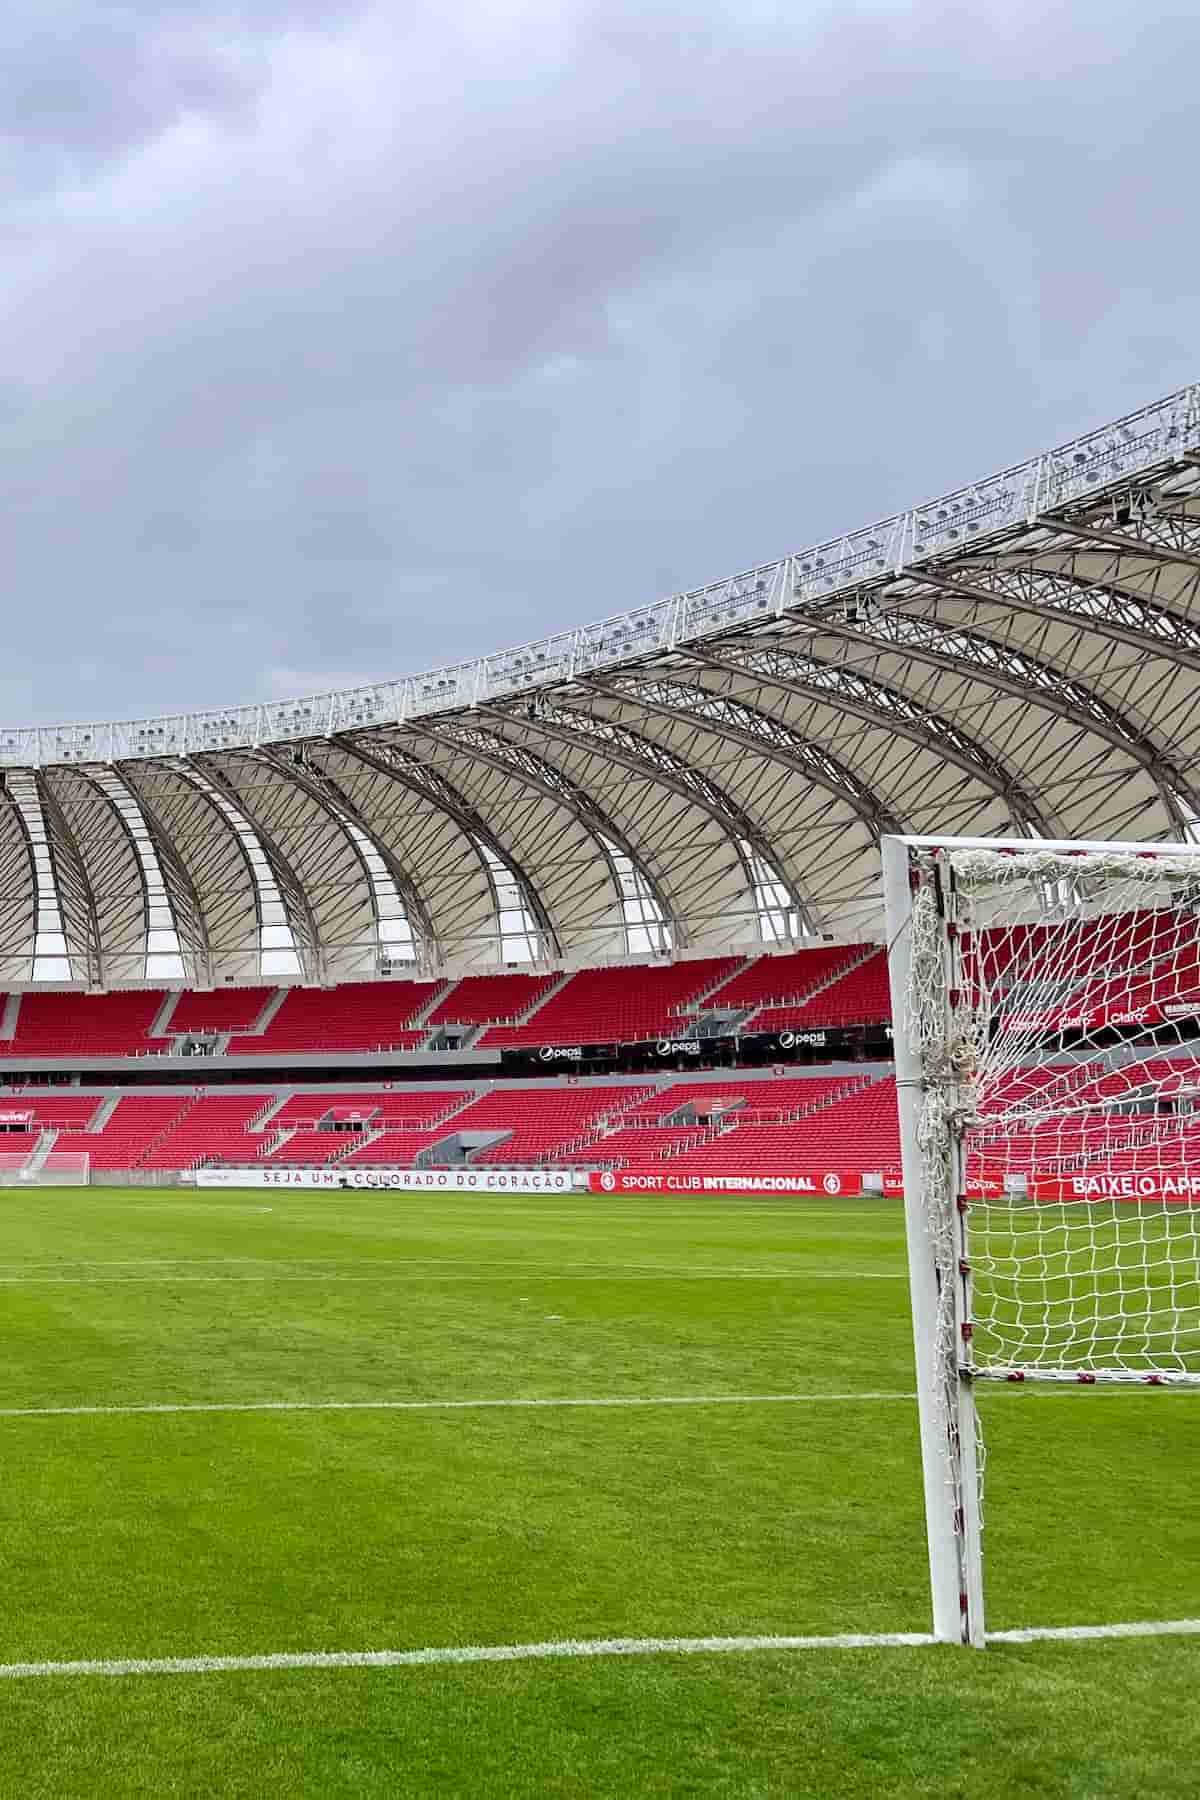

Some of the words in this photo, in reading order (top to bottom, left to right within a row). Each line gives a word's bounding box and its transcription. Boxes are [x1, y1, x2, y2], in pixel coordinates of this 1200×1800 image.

[1111, 1011, 1144, 1023] Claro
[795, 1031, 825, 1046] pepsi
[554, 1047, 582, 1059] pepsi
[672, 1040, 700, 1054] pepsi
[263, 1172, 303, 1184] SEJA
[311, 1173, 334, 1184] UM
[456, 1175, 477, 1186] DO
[622, 1176, 664, 1190] SPORT
[667, 1176, 701, 1190] CLUB
[703, 1177, 817, 1191] INTERNACIONAL
[1072, 1176, 1133, 1194] BAIXE
[1139, 1177, 1155, 1193] O
